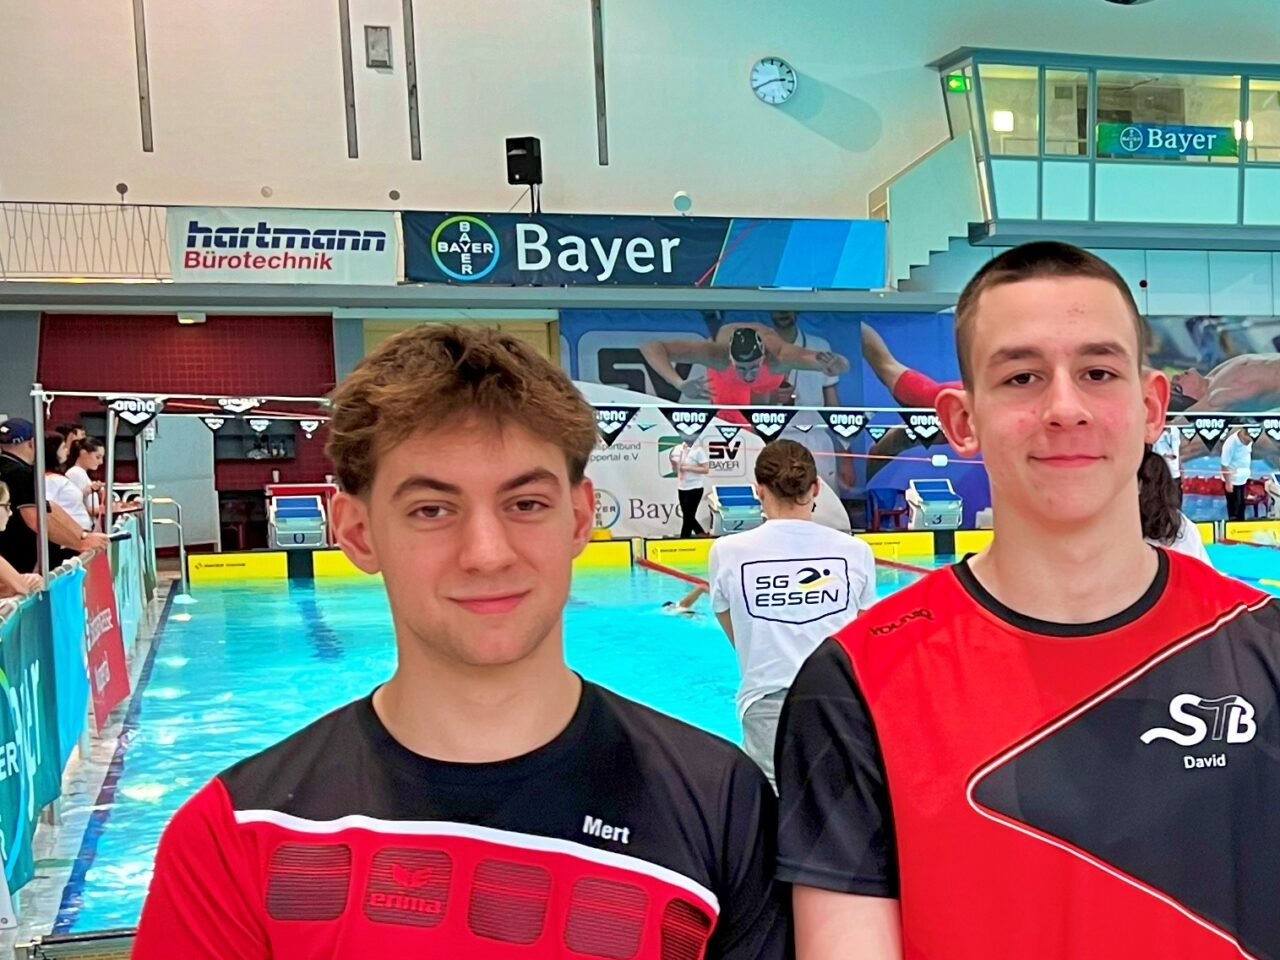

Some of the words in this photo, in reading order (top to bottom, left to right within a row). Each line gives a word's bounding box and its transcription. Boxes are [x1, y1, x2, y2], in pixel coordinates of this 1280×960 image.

[1147, 128, 1217, 153] Bayer
[187, 221, 387, 251] hartmann
[438, 241, 494, 254] BAYER
[516, 223, 681, 281] Bayer
[184, 251, 333, 271] Bürotechnik
[115, 399, 156, 412] arena
[672, 411, 708, 423] arena
[752, 412, 787, 424] arena
[830, 413, 865, 426] arena
[1196, 418, 1226, 429] arena
[709, 441, 741, 460] SV
[756, 575, 790, 590] SG
[755, 589, 839, 607] ESSEN
[1183, 753, 1227, 770] David
[582, 815, 630, 844] Mert
